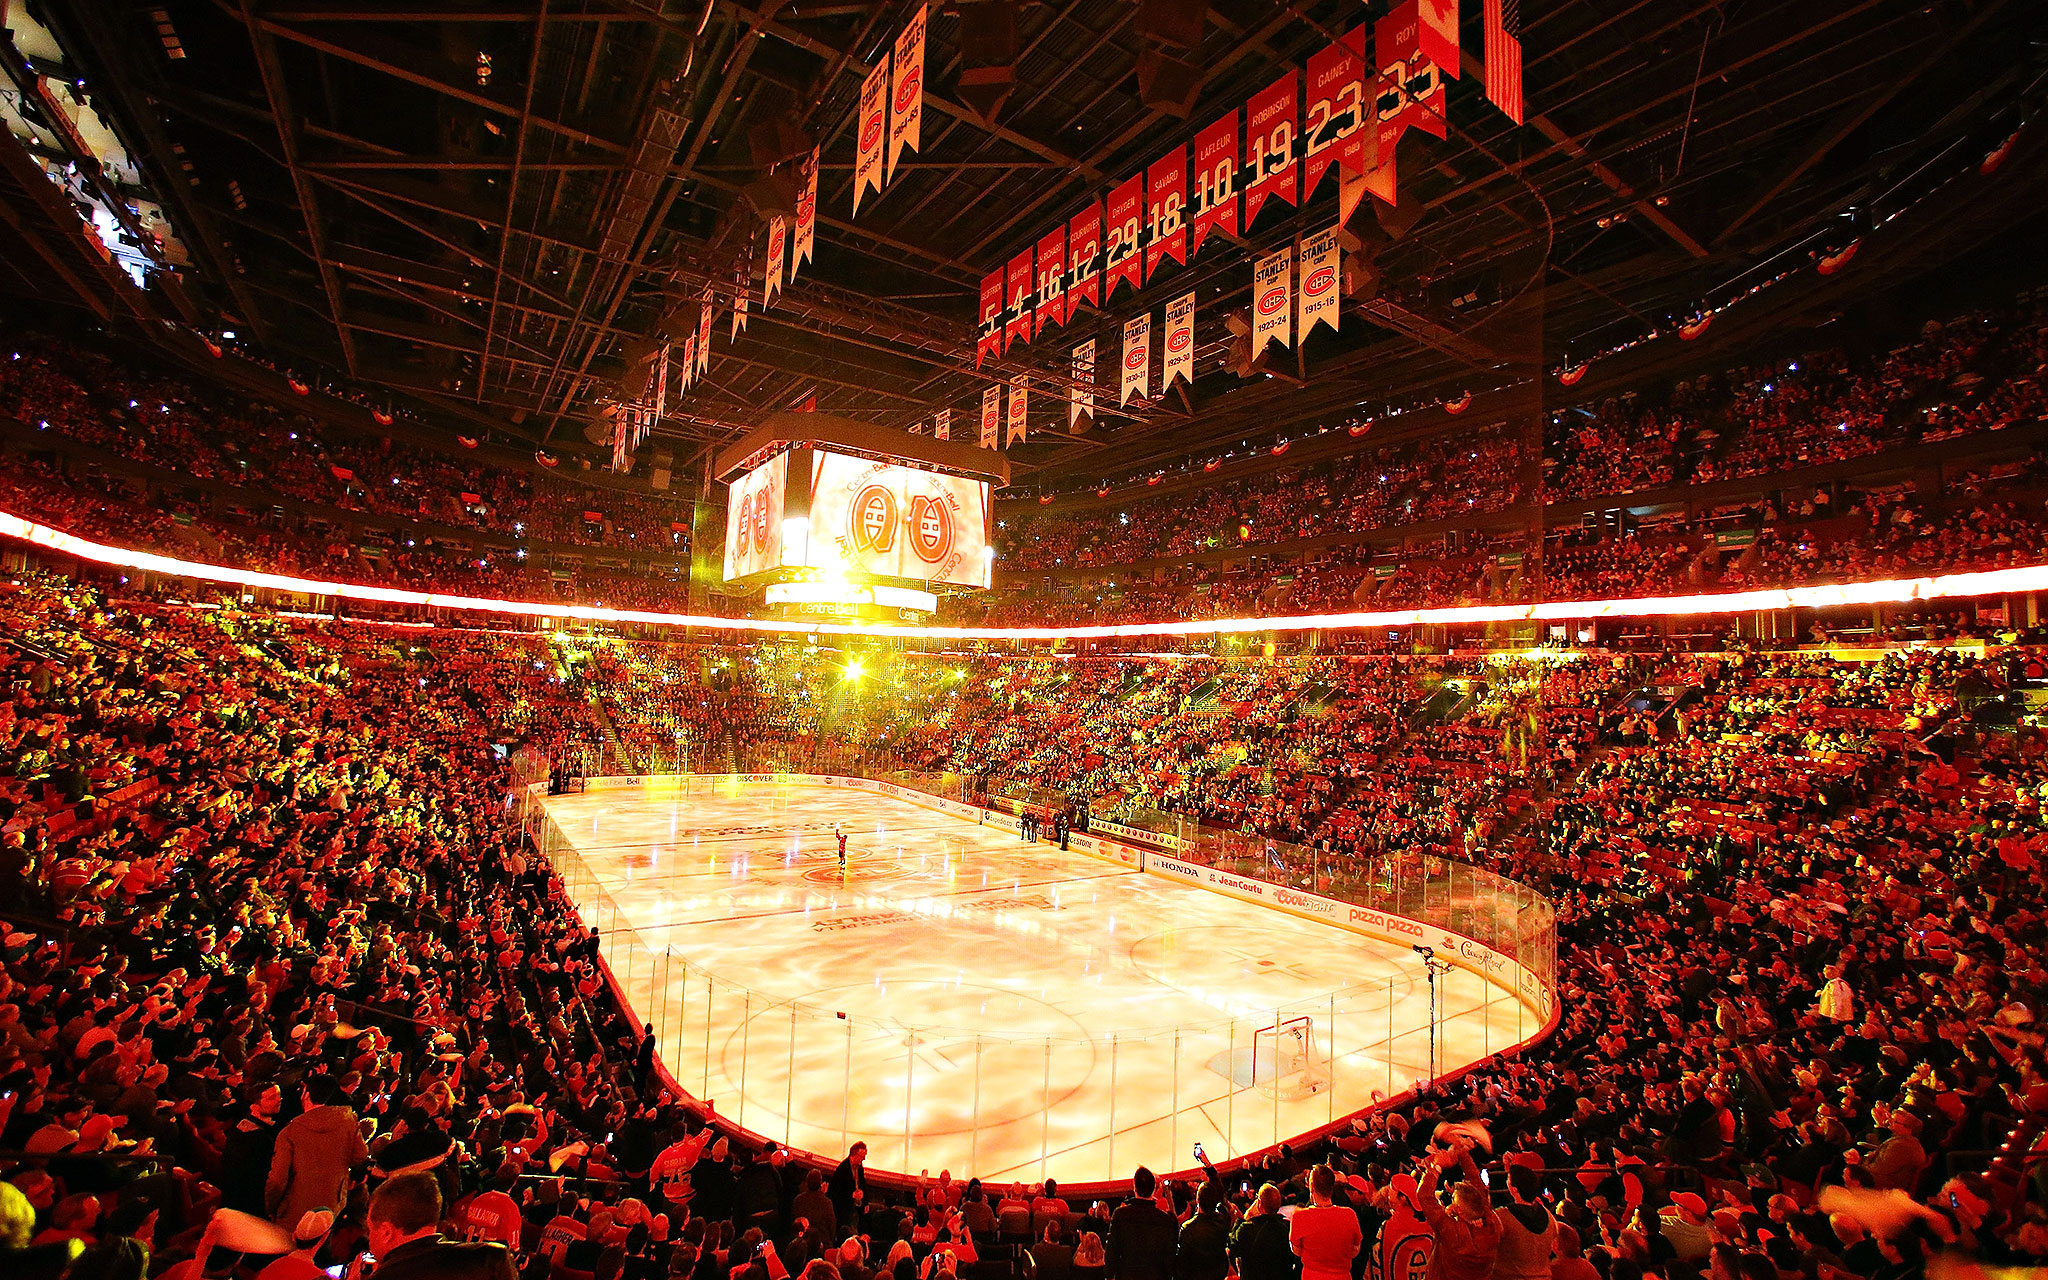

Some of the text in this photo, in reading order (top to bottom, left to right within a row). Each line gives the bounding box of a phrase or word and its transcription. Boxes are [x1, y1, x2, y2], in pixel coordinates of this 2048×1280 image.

[896, 24, 924, 68] STANLEY
[1396, 23, 1417, 46] ROY
[1318, 57, 1352, 88] GAINEY
[862, 69, 887, 110] STANLEY
[1252, 94, 1290, 127] ROBINSON
[1307, 80, 1362, 158] 23
[1200, 133, 1231, 161] LAFLEUR
[1380, 127, 1397, 143] 1984
[1251, 120, 1292, 188] 19
[1154, 169, 1179, 193] SAVARD
[1197, 156, 1232, 217] 10
[1112, 196, 1136, 218] DRYDEN
[1149, 191, 1181, 246] 18
[1070, 217, 1100, 243] COURNOYER
[1310, 231, 1330, 245] COUPE
[1107, 216, 1138, 270] 29
[1302, 237, 1338, 262] STANLEY
[1070, 240, 1097, 289] 12
[1256, 258, 1290, 282] STANLEY
[1264, 254, 1282, 267] COUPE
[1314, 255, 1326, 265] CUP
[1036, 262, 1061, 309] 16
[1267, 276, 1278, 285] CUP
[1011, 284, 1024, 321] 4
[1167, 302, 1194, 322] STANLEY
[1304, 296, 1334, 314] 1915-16
[984, 303, 995, 338] 5
[1125, 322, 1149, 341] STANLEY
[1258, 315, 1286, 332] 1923-24
[984, 392, 999, 405] STANLEY
[1658, 686, 1675, 696] Bell
[878, 782, 899, 796] RICOH
[1161, 861, 1199, 877] HONDA
[1218, 875, 1263, 895] Jean Coutu
[1349, 908, 1424, 938] pizza pizza
[467, 1206, 500, 1227] GALLAGHER
